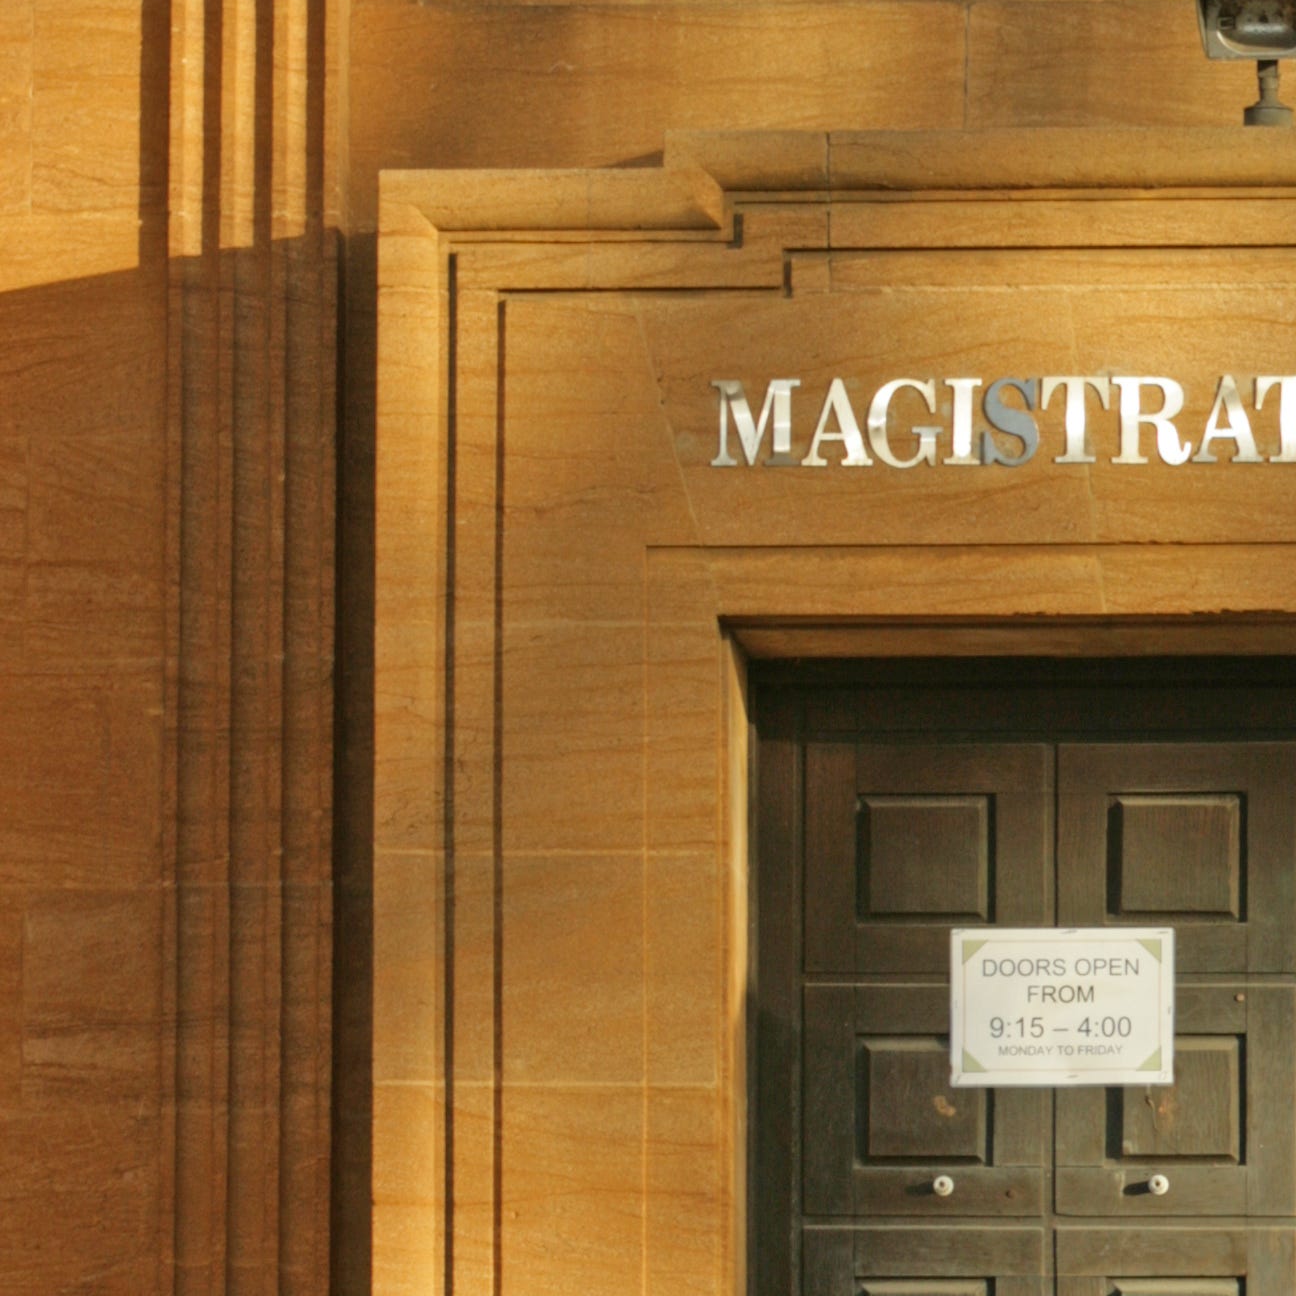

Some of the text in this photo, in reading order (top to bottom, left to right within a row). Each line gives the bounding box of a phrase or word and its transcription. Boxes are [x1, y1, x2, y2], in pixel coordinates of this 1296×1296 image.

[982, 958, 1140, 977] DOORS OPEN
[1027, 985, 1095, 1003] FROM
[989, 1016, 1045, 1038] 9:15
[1077, 1016, 1132, 1038] 4:00
[998, 1044, 1123, 1057] MONDAY TO FRIDAY
